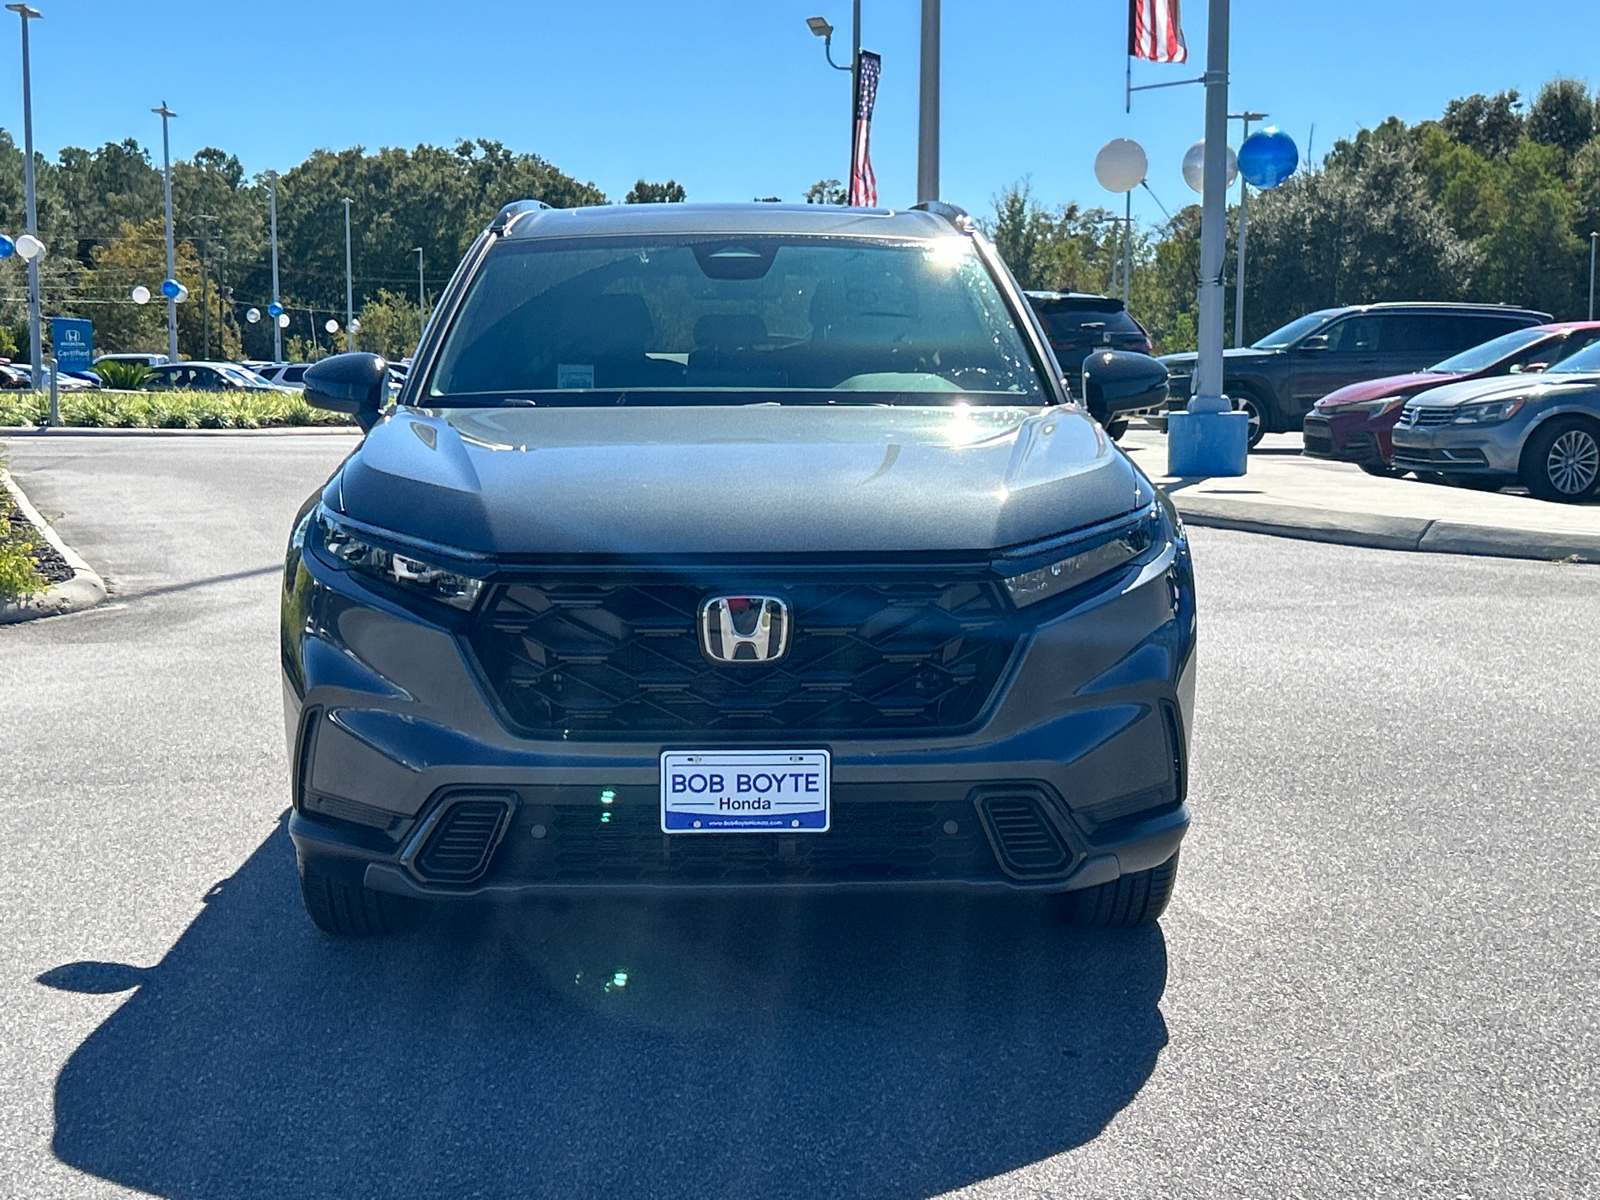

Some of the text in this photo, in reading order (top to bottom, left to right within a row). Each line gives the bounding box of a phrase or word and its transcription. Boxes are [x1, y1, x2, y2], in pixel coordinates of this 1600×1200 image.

[671, 773, 820, 793] BOB BOYTE
[719, 797, 771, 810] Honda
